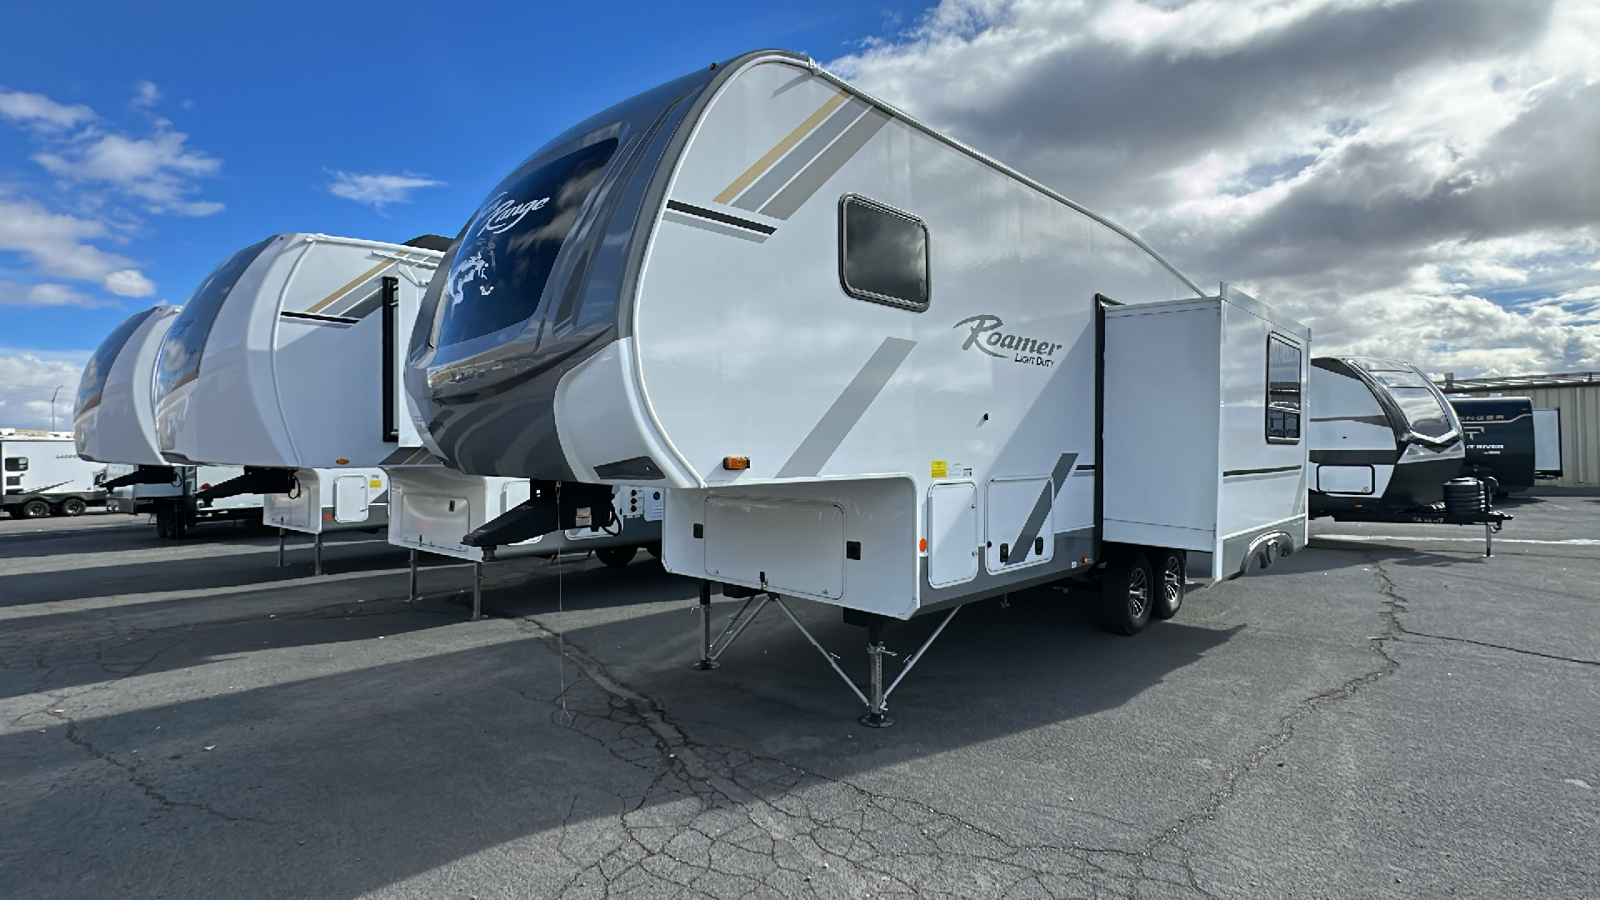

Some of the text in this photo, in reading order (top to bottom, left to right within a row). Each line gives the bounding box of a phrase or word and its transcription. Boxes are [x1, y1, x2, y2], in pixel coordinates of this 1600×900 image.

[476, 197, 551, 237] Range
[953, 314, 1062, 359] Roamer
[1014, 353, 1055, 368] LIGHT DUTY
